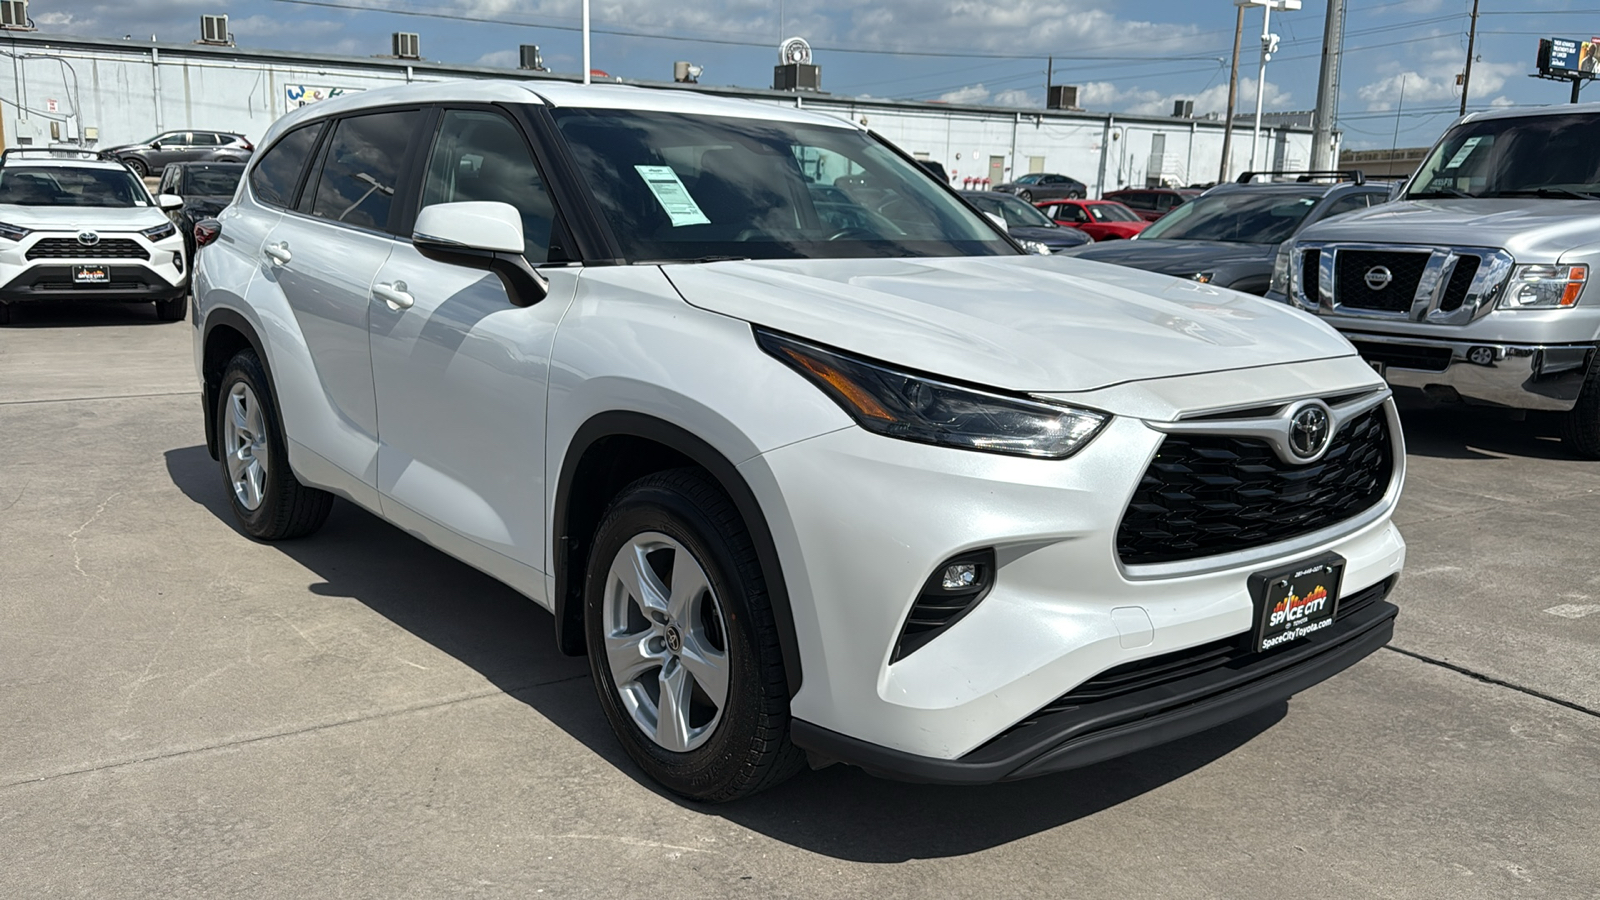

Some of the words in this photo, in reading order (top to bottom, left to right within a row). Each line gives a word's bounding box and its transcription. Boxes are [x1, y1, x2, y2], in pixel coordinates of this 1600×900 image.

[287, 85, 324, 101] Wee
[1269, 603, 1304, 626] SPACE
[1304, 596, 1327, 615] CITY
[1293, 617, 1308, 626] TOYOTA
[1262, 618, 1332, 649] SpaceCityToyota.com
